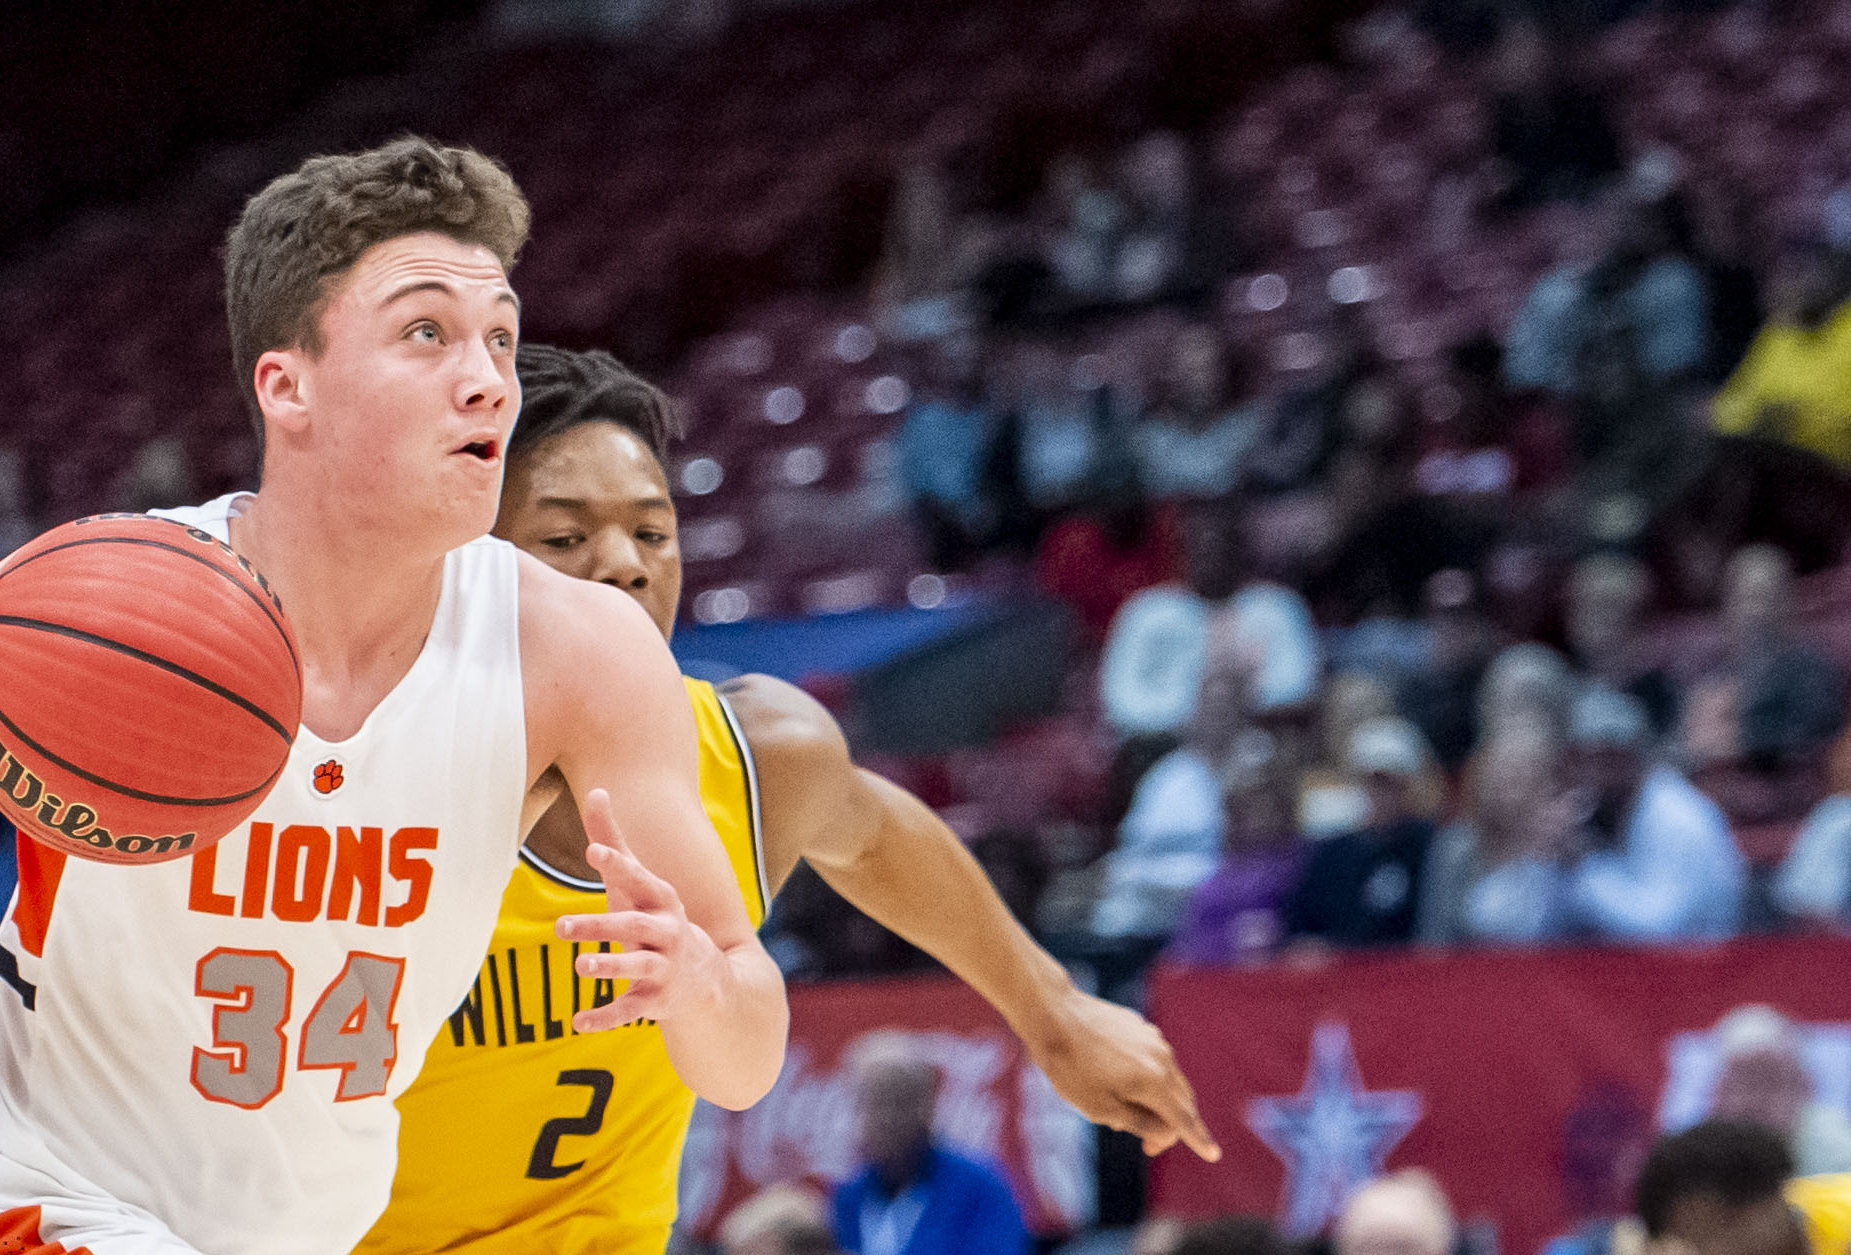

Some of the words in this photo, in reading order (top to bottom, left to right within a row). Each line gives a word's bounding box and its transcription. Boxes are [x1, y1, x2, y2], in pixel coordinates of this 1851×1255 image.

[188, 821, 439, 928] LIONS
[189, 946, 406, 1111] 34
[524, 1068, 614, 1180] 2
